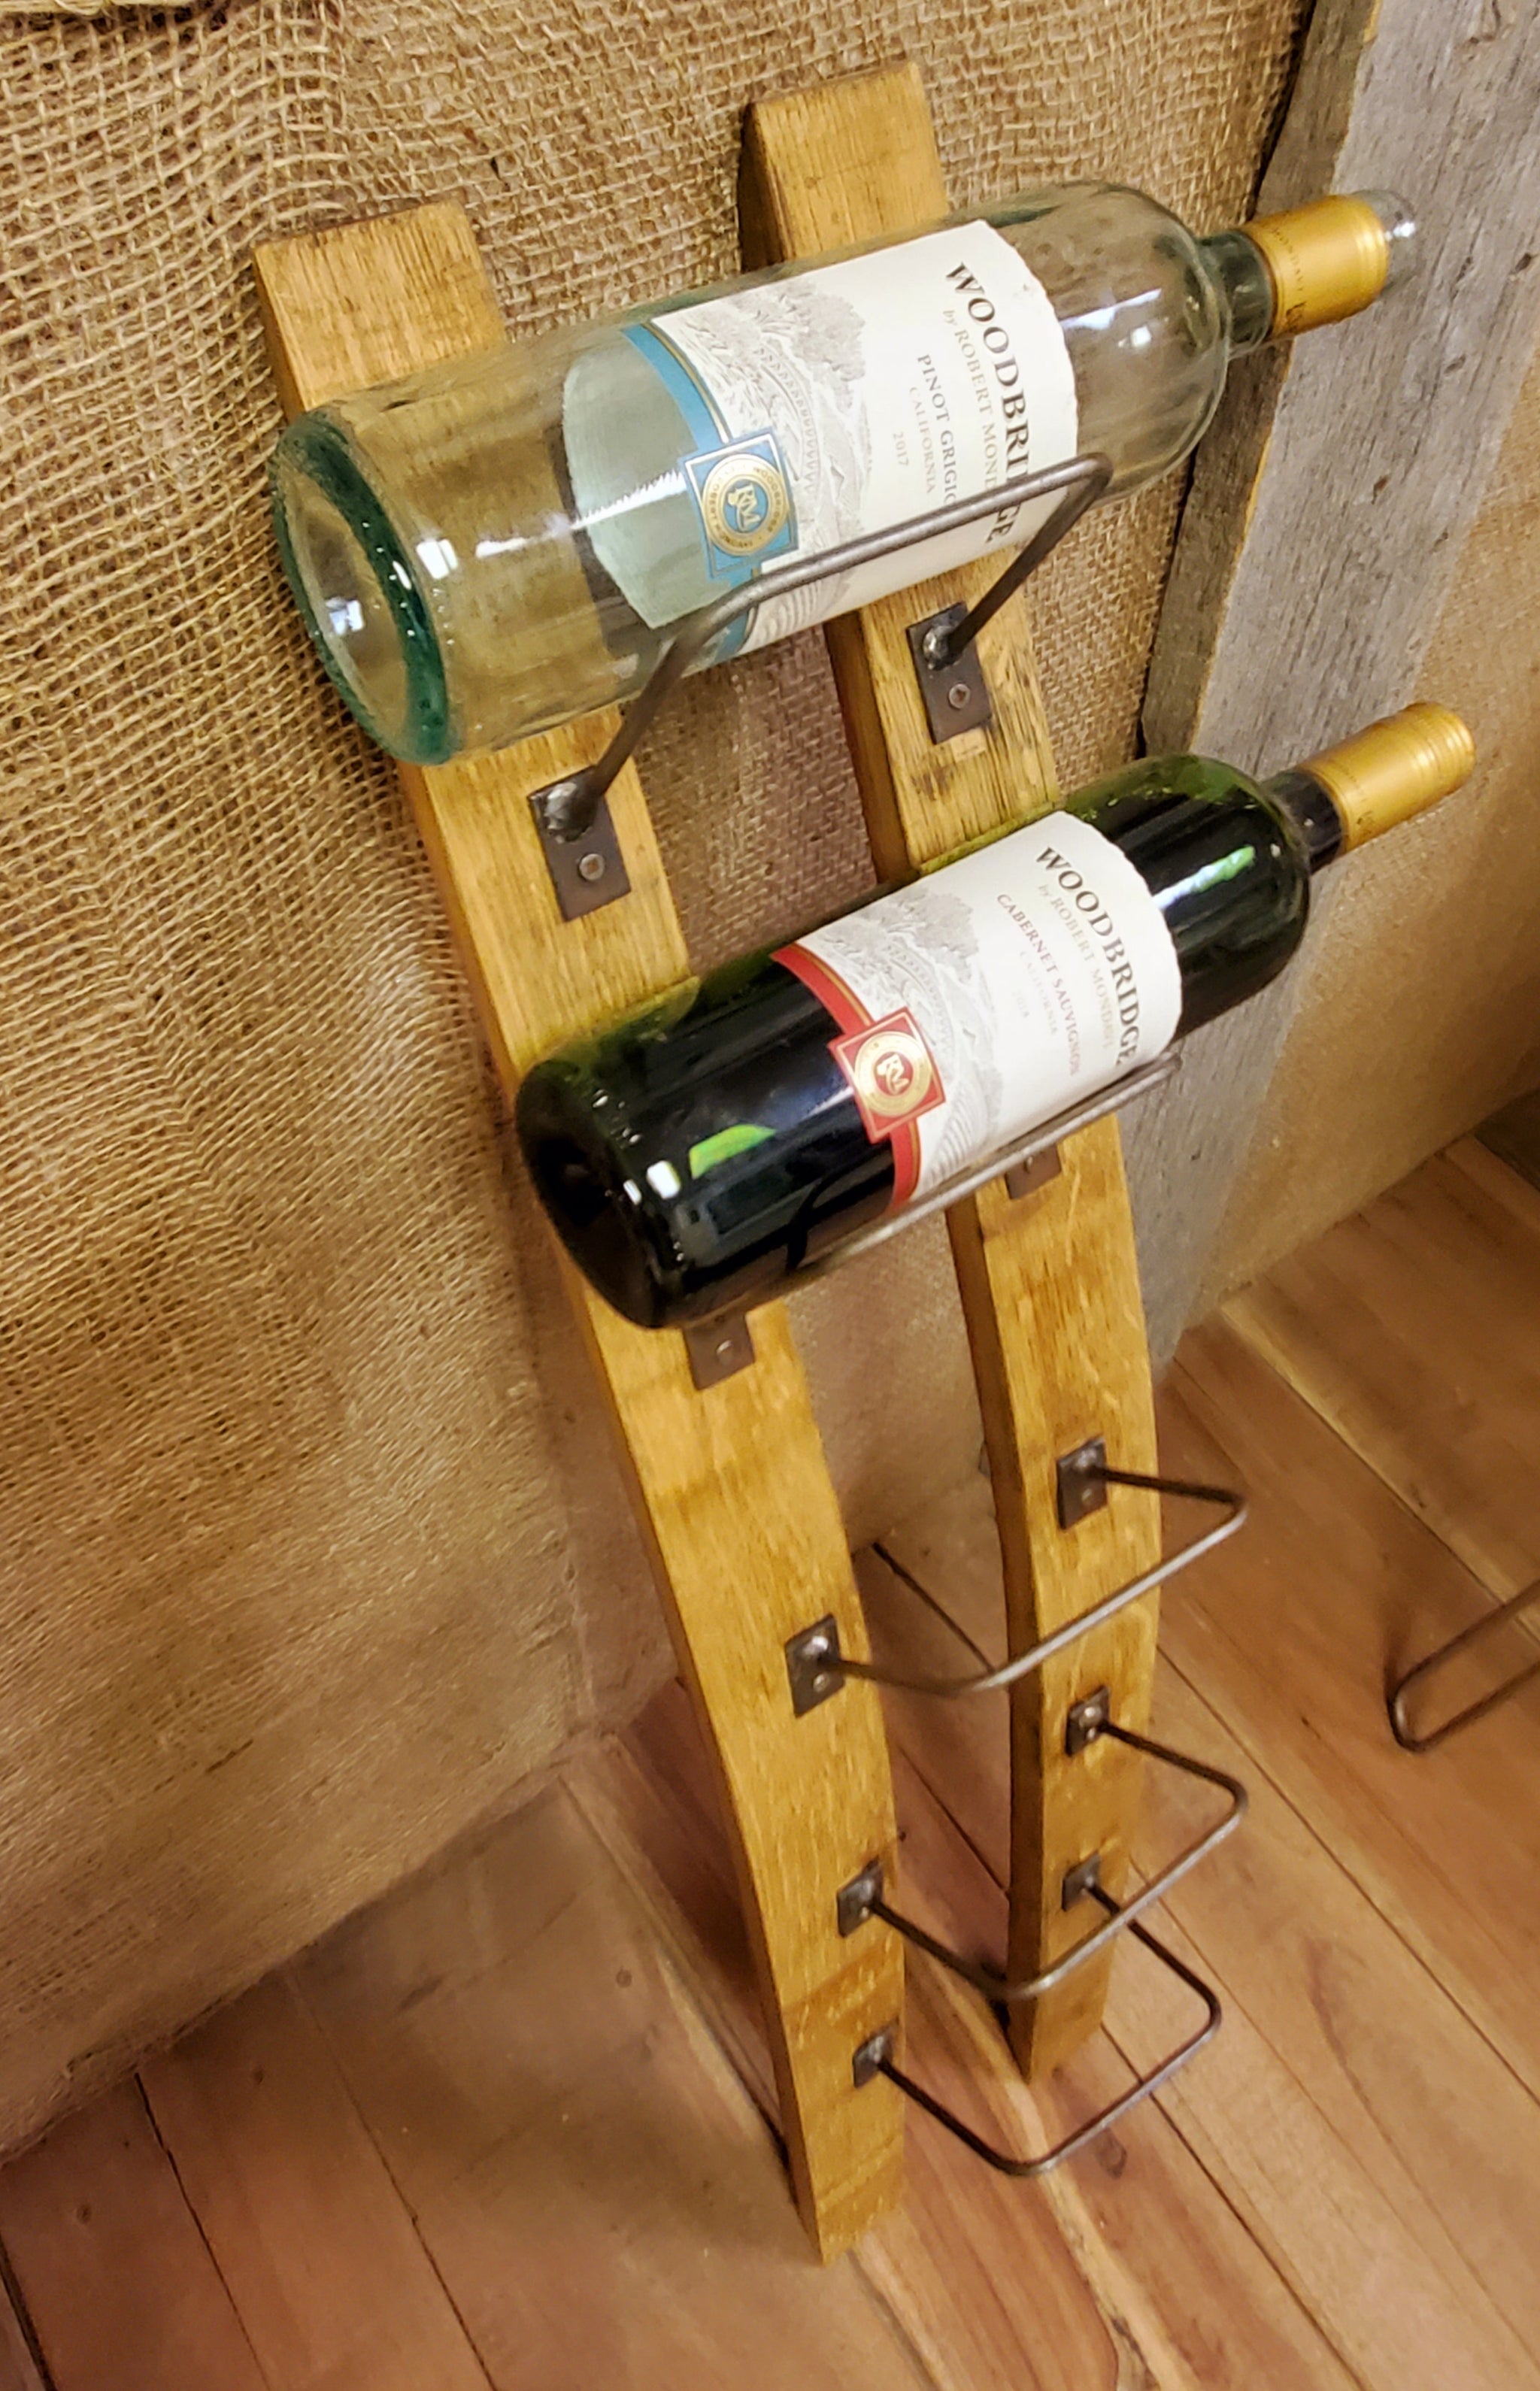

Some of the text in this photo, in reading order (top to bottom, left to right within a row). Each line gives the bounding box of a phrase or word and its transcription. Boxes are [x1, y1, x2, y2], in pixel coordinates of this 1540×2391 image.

[892, 432, 910, 468] 2017
[908, 386, 937, 494] CALIFORNIA
[917, 353, 950, 423] PINOT
[941, 308, 1000, 491] by ROBERT MOND
[946, 261, 1030, 544] WOODBRIGE
[996, 893, 1081, 1077] CABERNET SAUVIGNON
[1035, 846, 1140, 1066] WOODBRIDGE
[1050, 896, 1095, 962] ROBERT
